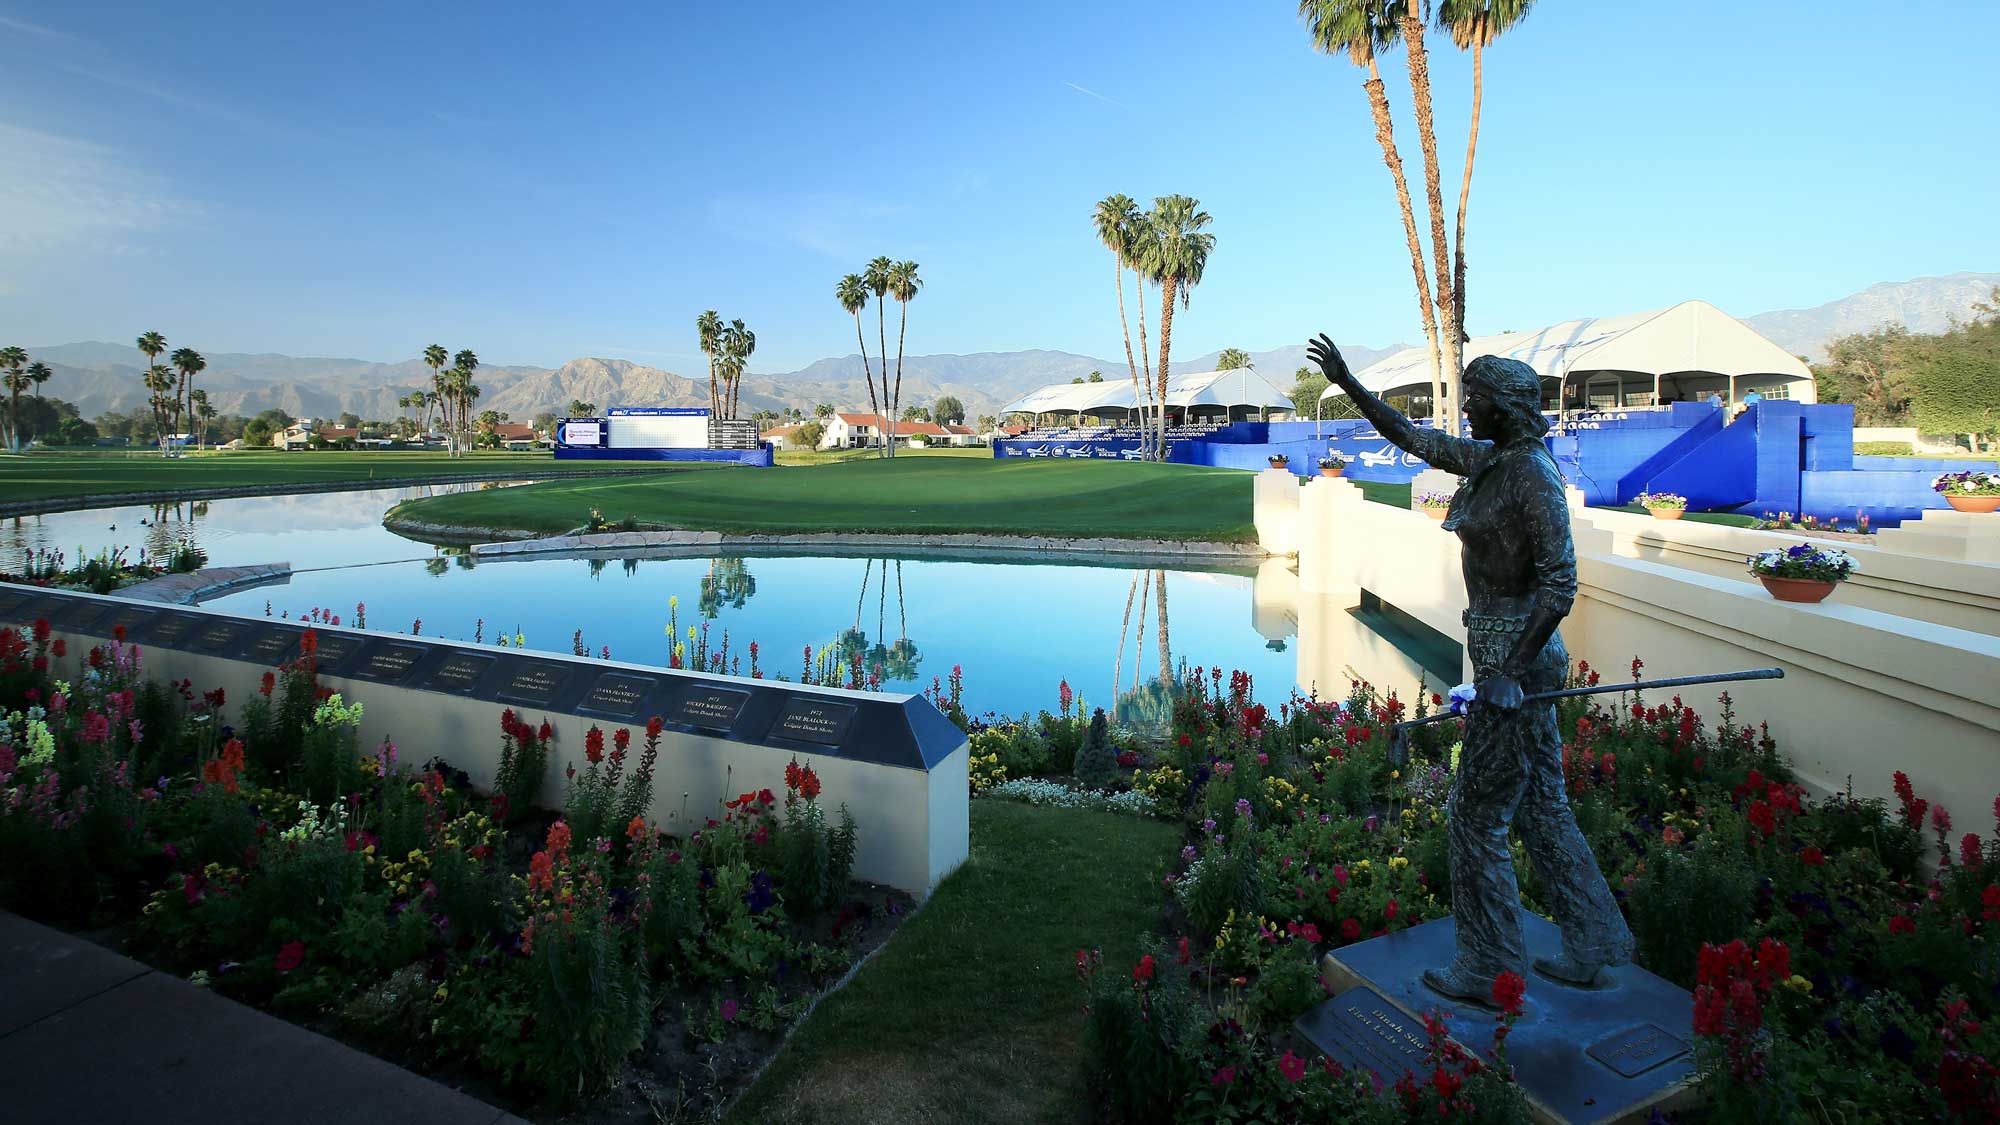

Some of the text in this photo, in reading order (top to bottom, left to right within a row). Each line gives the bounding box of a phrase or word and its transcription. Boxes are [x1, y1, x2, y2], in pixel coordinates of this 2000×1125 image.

[1347, 1006, 1372, 1025] First
[1373, 1024, 1399, 1045] Lady
[1371, 1008, 1403, 1033] Dinah
